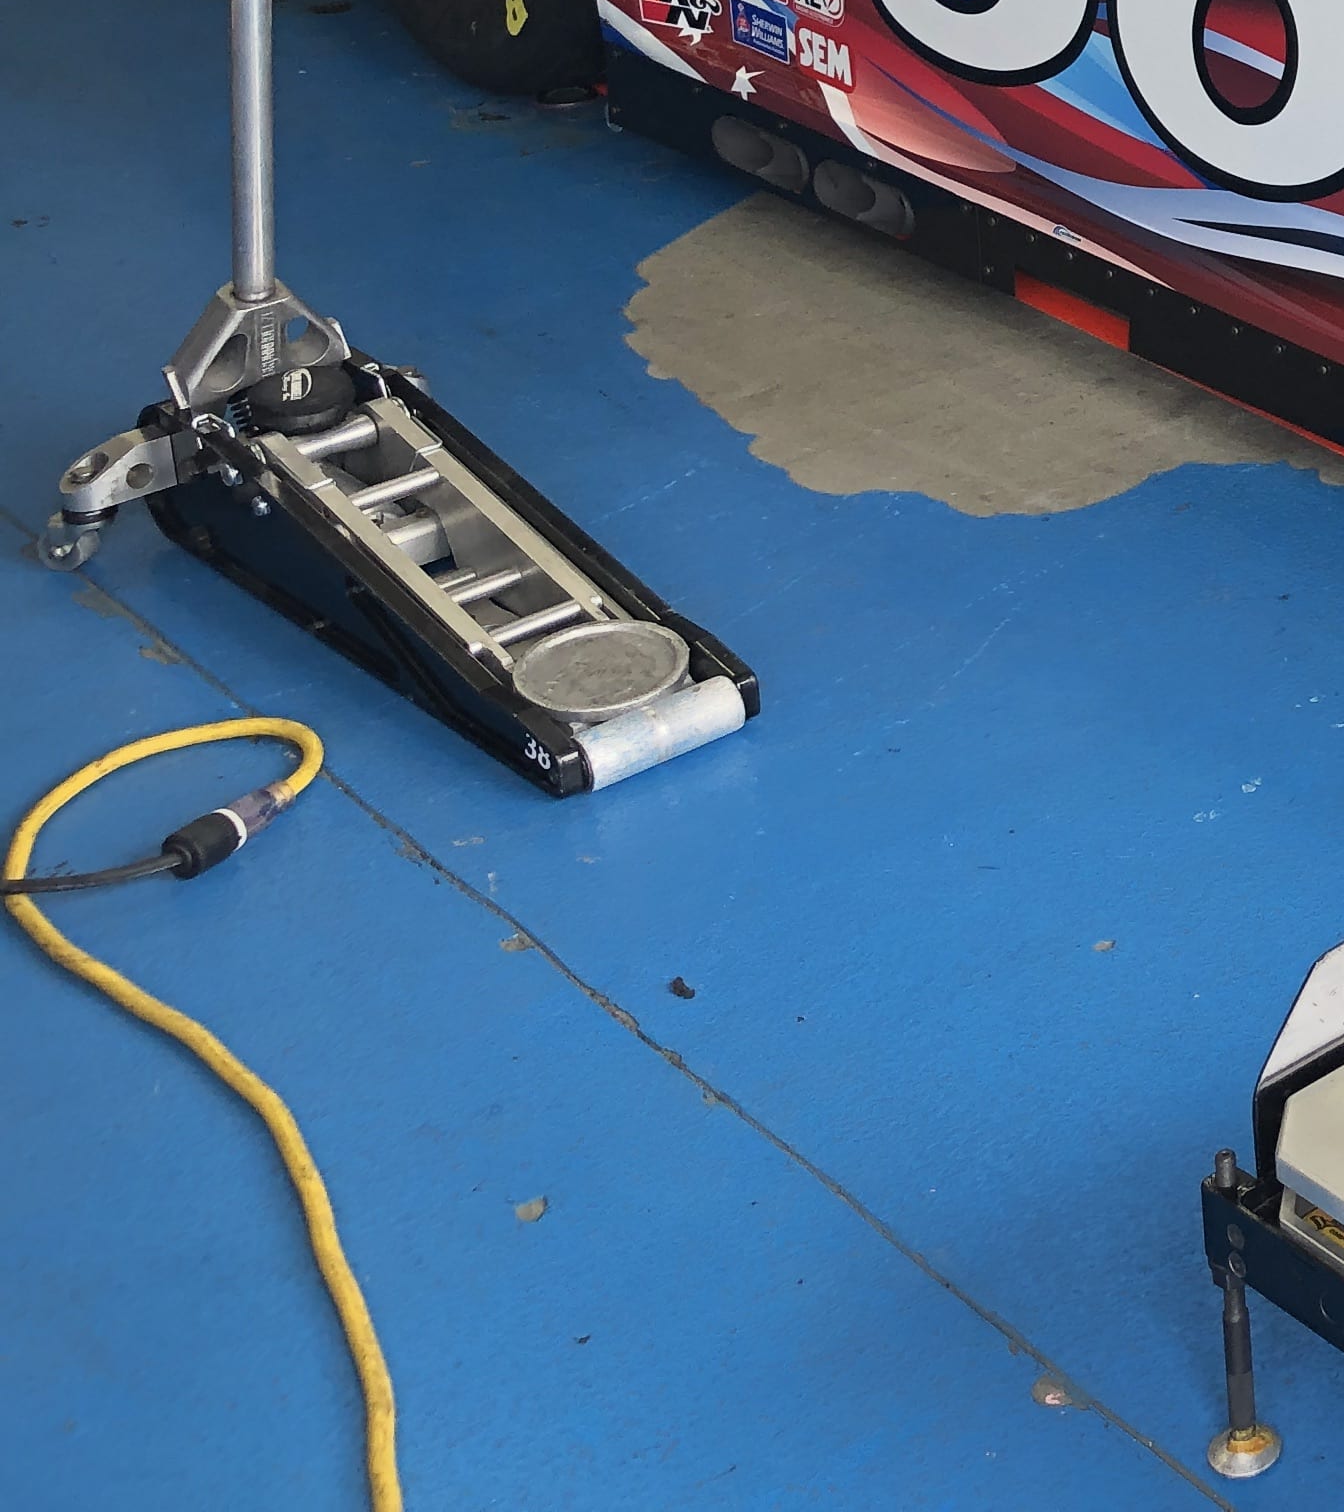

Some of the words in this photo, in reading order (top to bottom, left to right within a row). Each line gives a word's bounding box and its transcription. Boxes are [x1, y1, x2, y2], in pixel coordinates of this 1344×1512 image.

[750, 27, 785, 50] WILLIAMS
[751, 14, 784, 37] SHERWIN
[799, 29, 853, 88] SEM
[523, 731, 553, 771] 38
